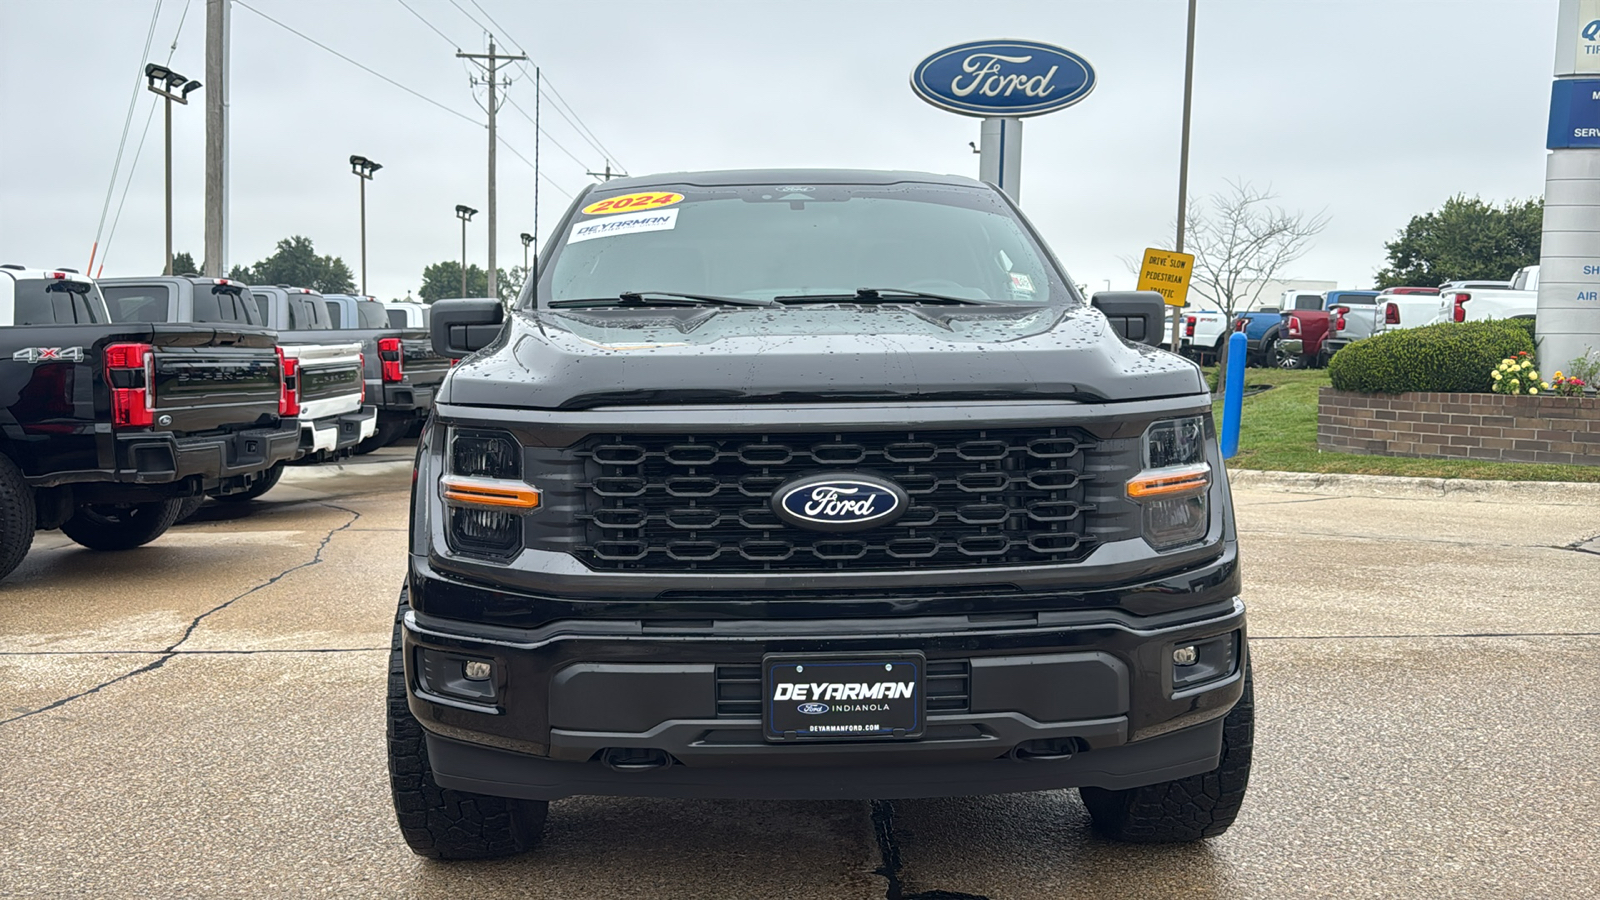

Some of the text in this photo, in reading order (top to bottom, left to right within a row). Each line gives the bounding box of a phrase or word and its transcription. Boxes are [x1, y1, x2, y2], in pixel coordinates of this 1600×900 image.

[951, 53, 1059, 97] Ford
[590, 194, 675, 213] 2024
[577, 216, 671, 235] DEYARMAN
[1149, 256, 1186, 269] DRIVE SLOW
[1146, 271, 1182, 283] PEDESTRIAN
[1577, 291, 1598, 301] AIR
[804, 486, 876, 516] Ford
[773, 682, 915, 701] DEYARMAN
[803, 703, 890, 713] Ford INDIANOLA
[809, 724, 880, 732] DEYARMANFORD.COM
